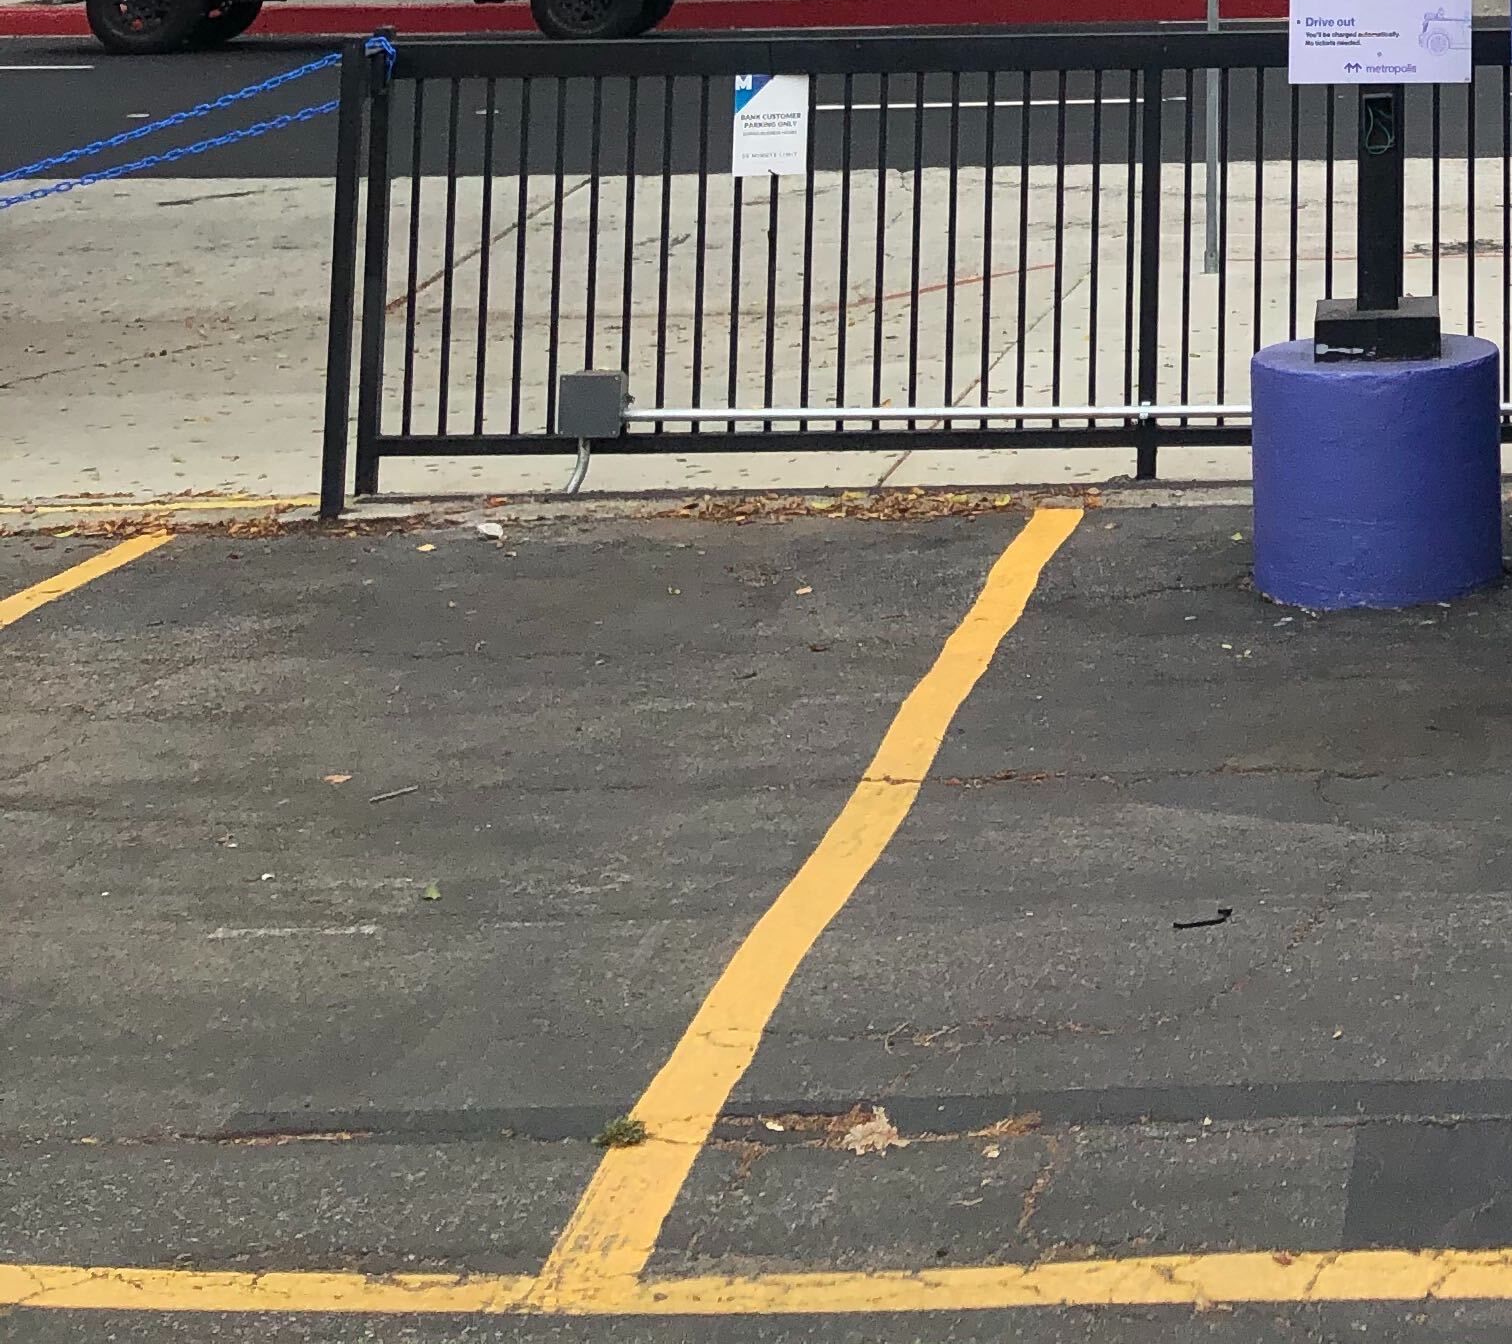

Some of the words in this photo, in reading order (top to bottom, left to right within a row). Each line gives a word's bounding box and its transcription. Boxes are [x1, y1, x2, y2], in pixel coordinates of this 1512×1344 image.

[1305, 17, 1334, 27] Drive
[1336, 17, 1355, 27] out
[1365, 63, 1417, 75] metropolis
